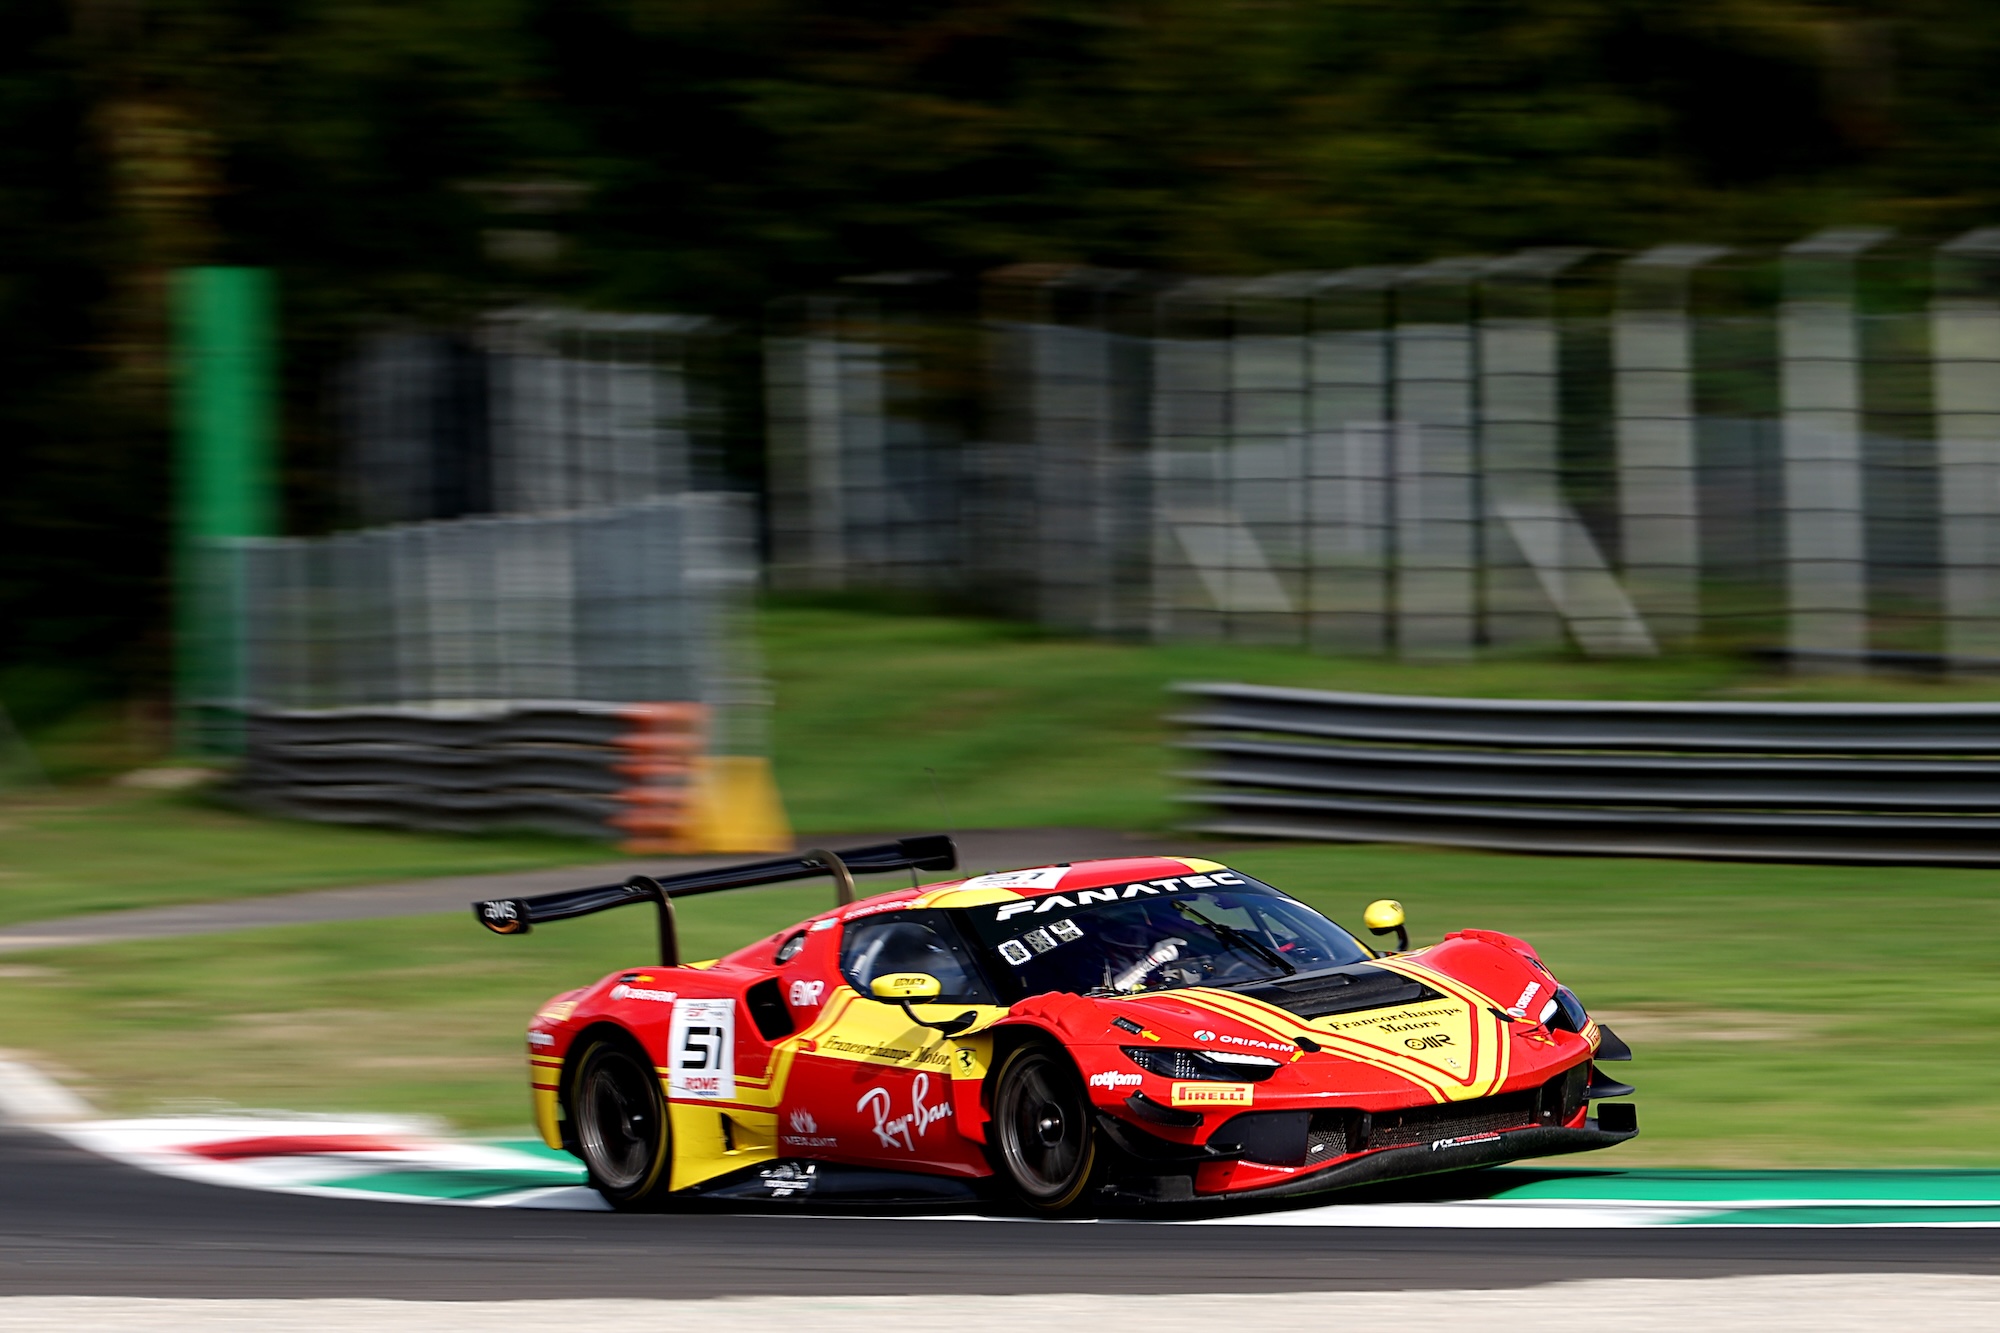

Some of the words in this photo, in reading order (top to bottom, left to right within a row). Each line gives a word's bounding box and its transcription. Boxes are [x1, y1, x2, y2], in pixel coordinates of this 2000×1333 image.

[996, 872, 1246, 921] FANATEC
[1327, 1007, 1463, 1031] Francorchamps
[1378, 1020, 1441, 1034] Motors
[682, 1026, 723, 1070] 51
[822, 1035, 914, 1064] Francorchamps
[1219, 1034, 1295, 1053] ORIFARM
[1179, 1087, 1246, 1101] PIRELLI
[856, 1072, 953, 1152] Ray-Ban
